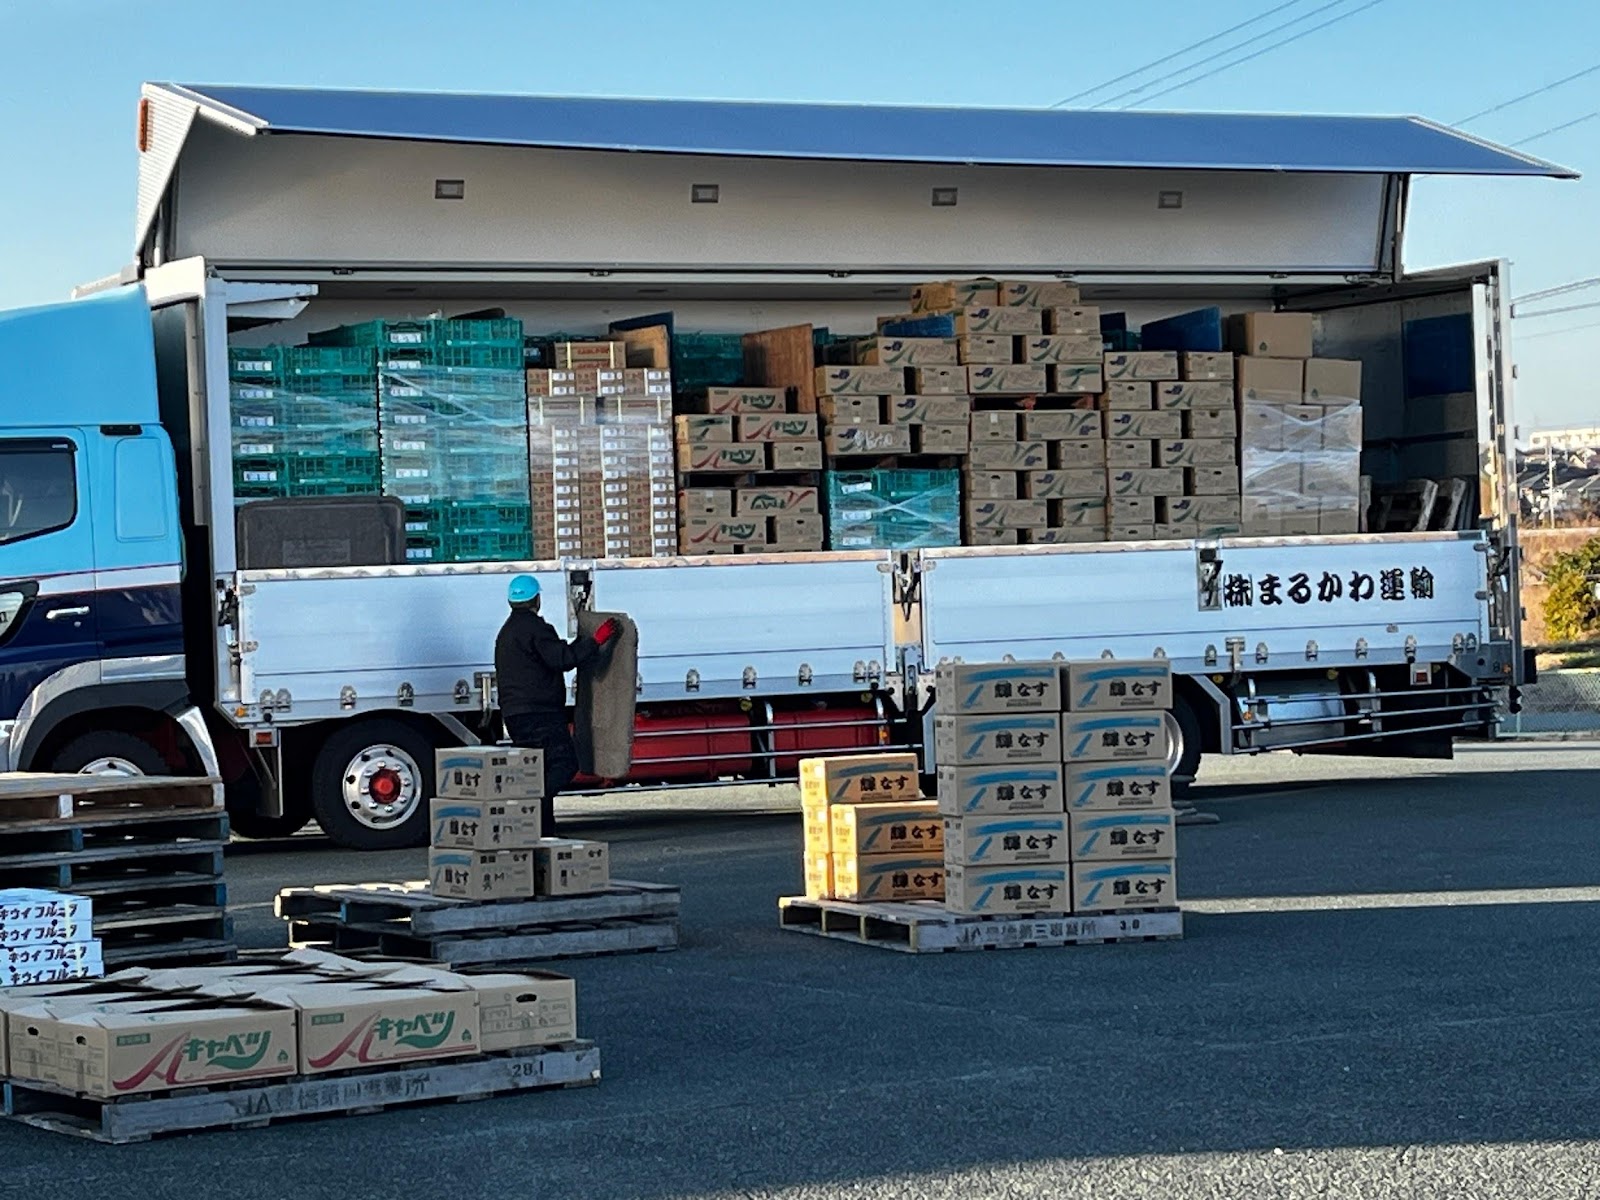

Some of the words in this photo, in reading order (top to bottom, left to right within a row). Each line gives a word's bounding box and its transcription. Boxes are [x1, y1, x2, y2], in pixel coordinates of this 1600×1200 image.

[373, 1010, 456, 1049] キャベツ
[183, 1030, 272, 1071] キャベツ
